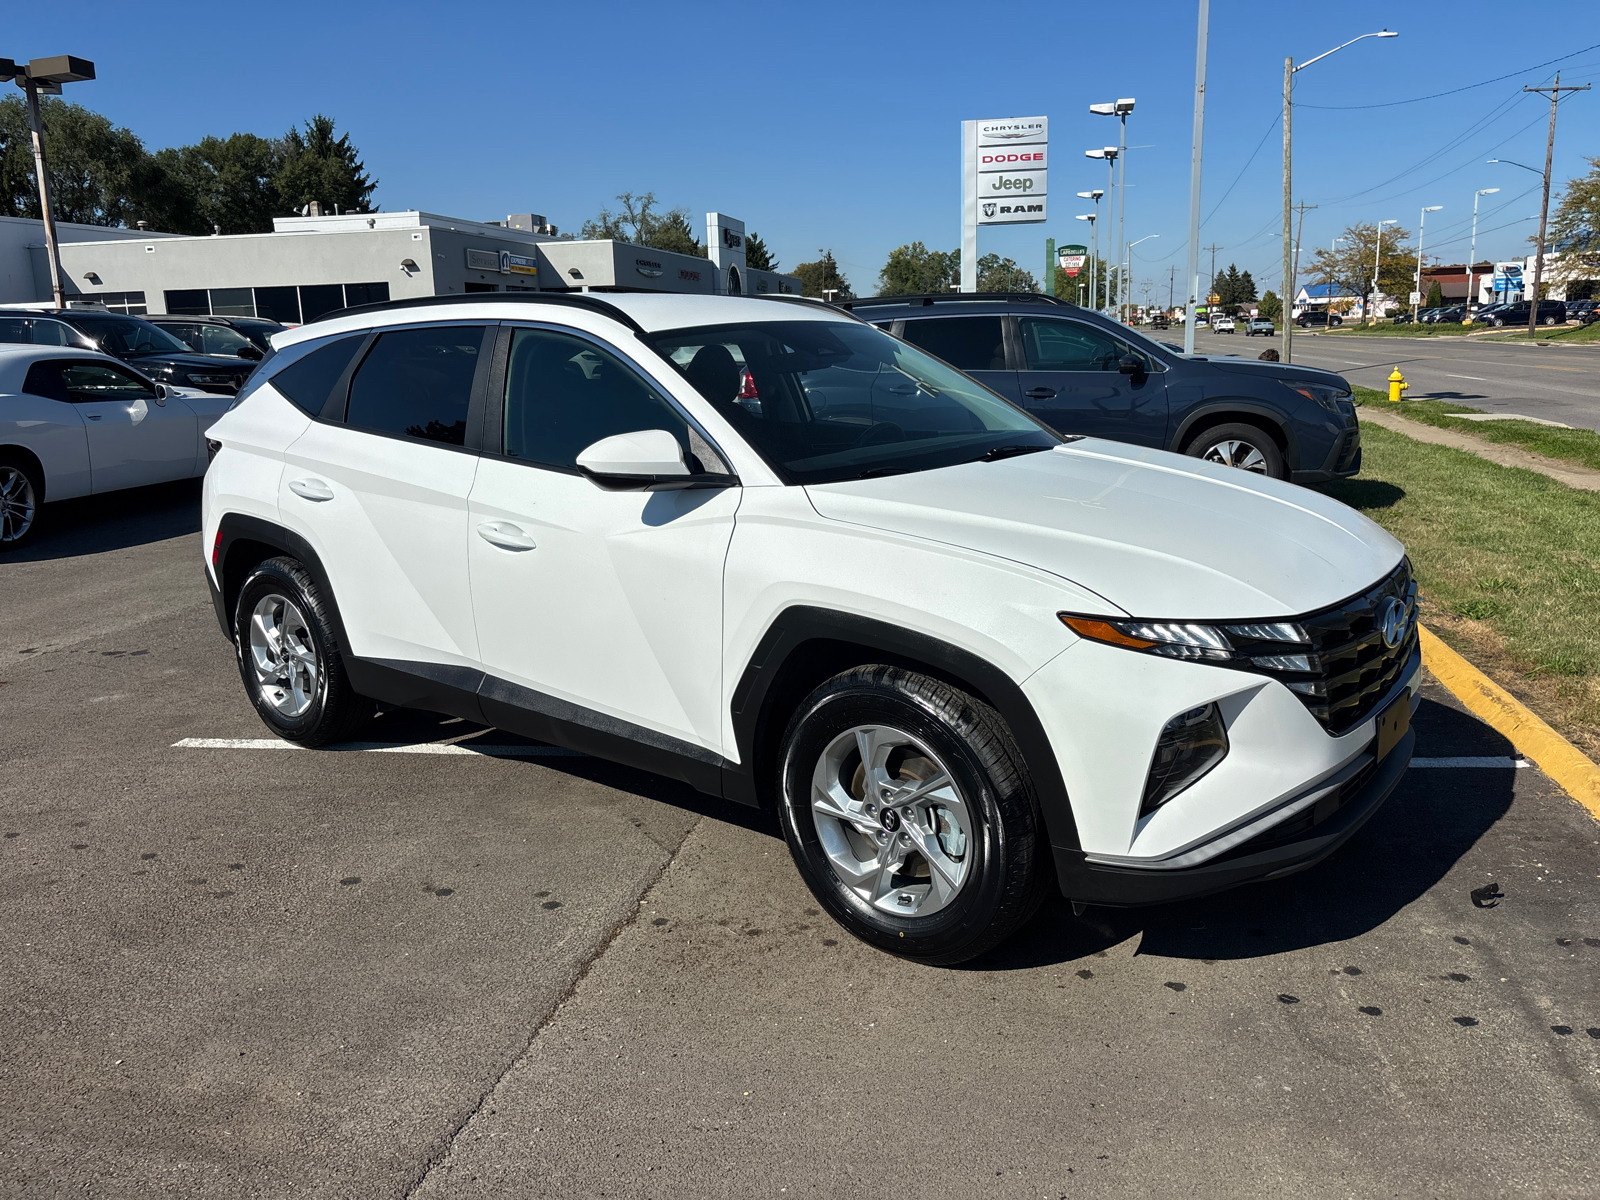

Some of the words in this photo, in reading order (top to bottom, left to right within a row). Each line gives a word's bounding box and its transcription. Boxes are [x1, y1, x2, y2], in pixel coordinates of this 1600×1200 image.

[983, 123, 1043, 132] CHRYSLER
[982, 153, 1044, 163] DODGE
[992, 176, 1033, 192] Jeep
[1000, 204, 1043, 214] RAM
[471, 255, 498, 267] Service
